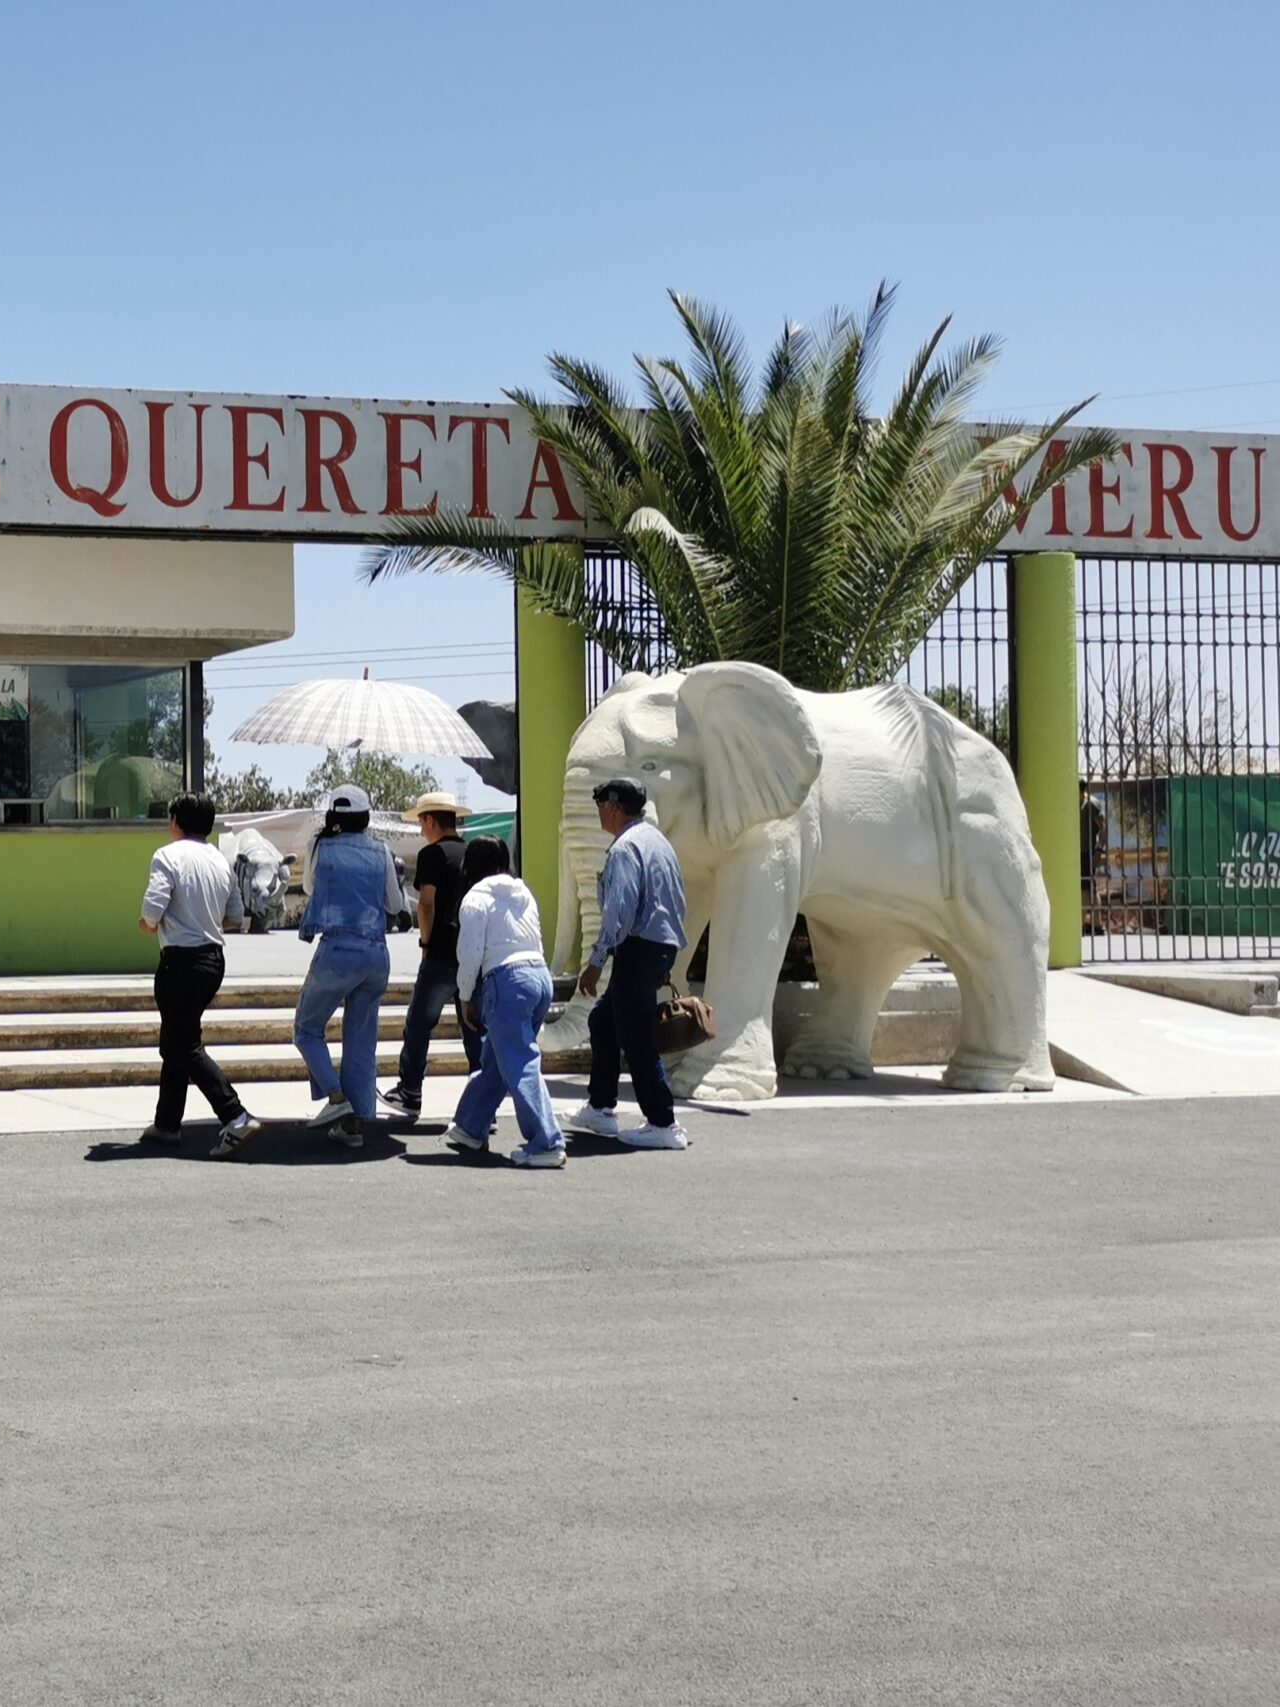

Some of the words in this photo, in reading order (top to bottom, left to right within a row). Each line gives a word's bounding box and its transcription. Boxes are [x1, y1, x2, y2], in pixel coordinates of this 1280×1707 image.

[49, 398, 587, 520] QUERETA
[971, 434, 1266, 542] MERU
[1239, 862, 1280, 889] SOR
